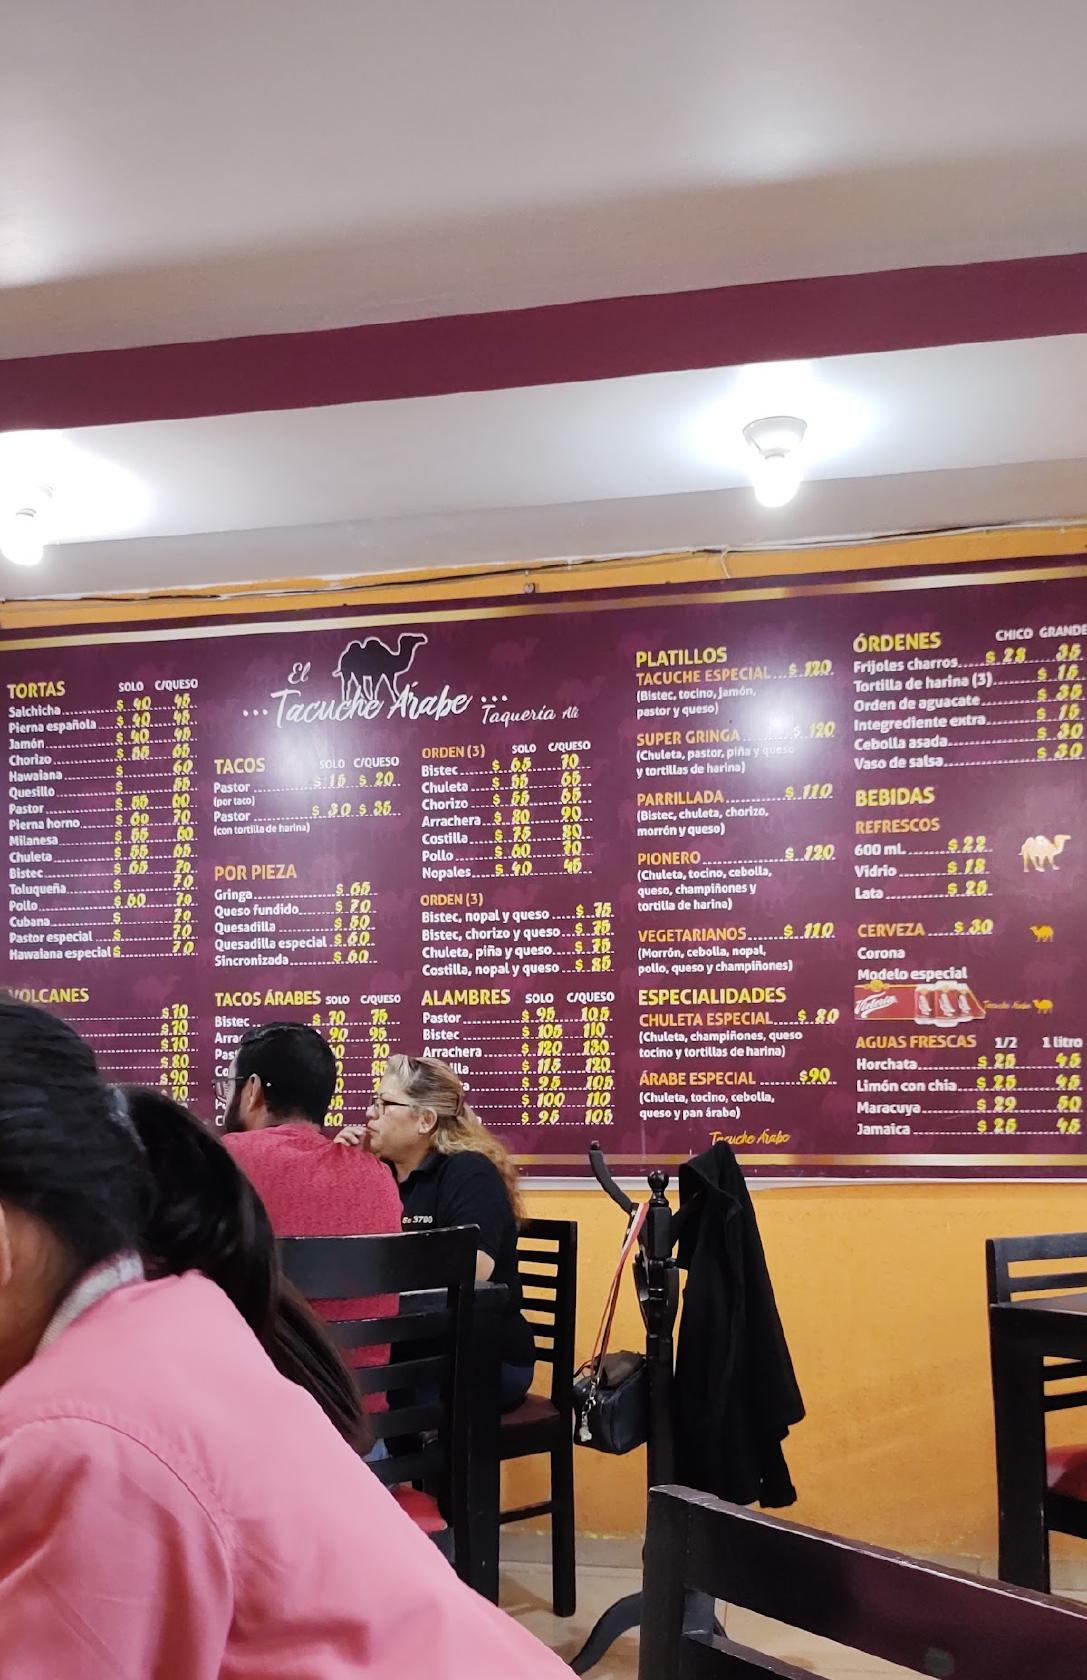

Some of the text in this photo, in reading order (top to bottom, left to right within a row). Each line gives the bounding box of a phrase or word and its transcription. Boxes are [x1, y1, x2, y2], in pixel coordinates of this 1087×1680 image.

[996, 628, 1033, 641] CHICO
[853, 632, 941, 653] ÓRDENES
[636, 647, 727, 668] PLATILLOS
[288, 662, 311, 684] El
[854, 657, 958, 675] Frijoles charros
[636, 667, 771, 686] TACUCHE ESPECIAL
[854, 672, 992, 693] Tortilla de harina (3)
[7, 681, 66, 699] TORTAS
[118, 679, 198, 692] SOLO C/QUESO
[387, 681, 473, 720] Árabe
[854, 695, 981, 712] Orden de aguacate
[9, 706, 61, 718] Salchicha
[271, 688, 384, 728] Tacuche
[481, 705, 556, 728] Taquería
[854, 714, 986, 733] Integrediente extra
[9, 719, 96, 734] Pierna española
[9, 738, 45, 750] Jamón
[637, 729, 740, 747] SUPER GRINGA
[854, 736, 948, 750] Cebolla asada
[422, 744, 485, 759] ORDEN (3)
[512, 741, 591, 754] SOLO C/QUESO
[9, 755, 52, 766] Chorizo
[214, 758, 265, 775] TACOS
[320, 756, 399, 769] SOLO C/QUESO
[854, 755, 944, 770] Vaso de salsa
[9, 770, 63, 782] Hawaiana
[422, 765, 458, 777] Bistec
[9, 786, 55, 800] Quesillo
[214, 782, 250, 793] Pastor
[422, 782, 468, 794] Chuleta
[214, 796, 255, 807] (por taco)
[637, 790, 724, 806] PARRILLADA
[855, 787, 935, 807] BEBIDAS
[9, 804, 44, 815] Pastor
[422, 798, 468, 811] Chorizo
[9, 816, 80, 830] Pierna horno
[214, 811, 250, 822] Pastor
[422, 815, 481, 827] Arrachera
[855, 818, 940, 834] REFRESCOS
[9, 836, 58, 846] Milanesa
[422, 832, 468, 845] Costilla
[422, 850, 453, 862] Pollo
[854, 844, 881, 856] 600
[9, 852, 52, 863] Chuleta
[638, 851, 701, 865] PIONERO
[9, 868, 43, 879] Bistec
[215, 864, 297, 881] POR PIEZA
[422, 867, 471, 881] Nopales
[855, 865, 897, 878] Vidrio
[9, 883, 66, 897] Toluqueña
[215, 889, 253, 902] Gringa
[855, 887, 884, 899] Lata
[9, 900, 38, 911] Pollo
[420, 893, 484, 907] ORDEN (3)
[215, 904, 299, 917] Queso fundido
[422, 910, 549, 924] Bistec, nopal queso
[9, 916, 50, 928] Cubana
[215, 922, 276, 935] Quesadilla
[422, 927, 560, 942] Bistec, chorizo queso
[638, 927, 746, 943] VEGETARIANOS
[857, 923, 925, 938] CERVEZA
[9, 931, 92, 945] Pastor especial
[215, 936, 327, 952] Quesadilla especial
[9, 946, 111, 961] Hawaiana especial
[422, 945, 552, 960] Chuleta, piña queso
[857, 948, 906, 959] Corona
[215, 954, 289, 966] Sincronizada
[422, 963, 559, 977] Costilla, nopal queso
[638, 960, 793, 976] pollo, queso champiñones)
[857, 967, 968, 982] Modelo especial
[215, 989, 321, 1007] TACOS ÁRABES
[325, 994, 401, 1005] SOLO C/QUESO
[421, 990, 511, 1005] ALAMBRES
[525, 992, 615, 1003] SOLO C/QUESO
[638, 987, 786, 1006] ESPECIALIDADES
[215, 1016, 250, 1027] Bistec
[423, 1012, 461, 1024] Pastor
[639, 1012, 773, 1027] CHULETA ESPECIAL
[423, 1029, 460, 1040] Bistec
[639, 1031, 803, 1044] (Chuleta, champiñones, queso
[856, 1035, 1083, 1049] AGUAS FRESCAS 1/2 1 litro
[423, 1047, 482, 1058] Arrachera
[639, 1045, 786, 1058] tocino tortillas de harina)
[856, 1058, 918, 1070] Horchata
[639, 1070, 756, 1086] ÁRABE ESPECIAL
[856, 1079, 957, 1092] Limón con chia
[857, 1102, 921, 1116] Maracuya
[857, 1124, 910, 1135] Jamaica
